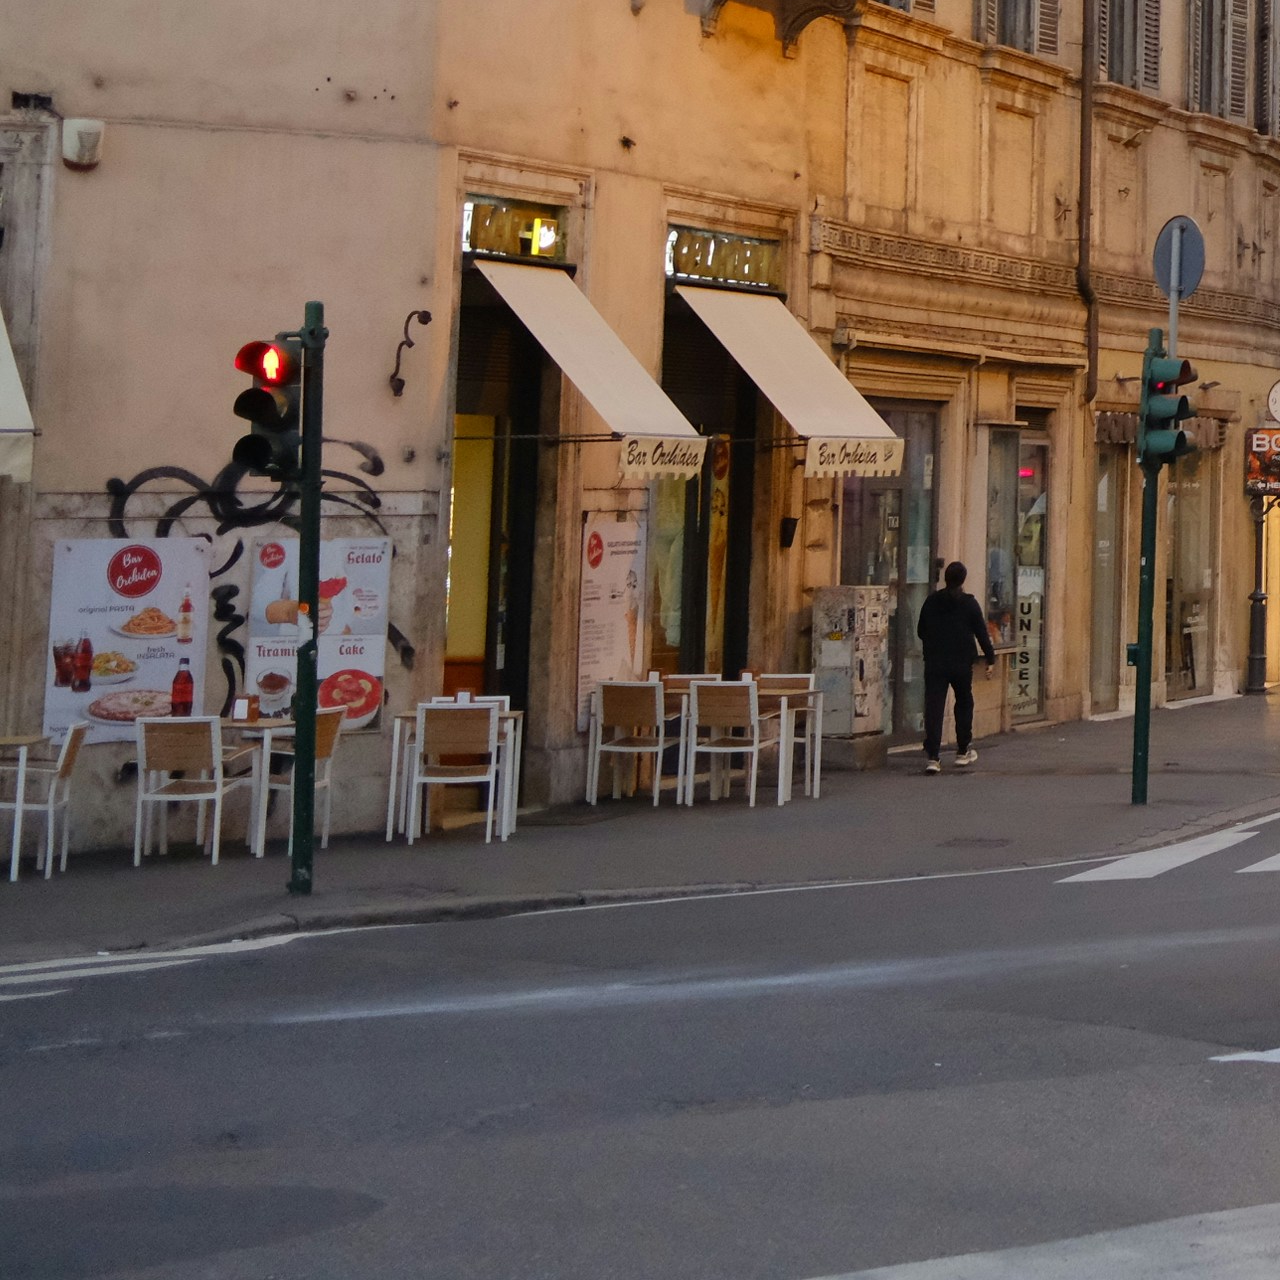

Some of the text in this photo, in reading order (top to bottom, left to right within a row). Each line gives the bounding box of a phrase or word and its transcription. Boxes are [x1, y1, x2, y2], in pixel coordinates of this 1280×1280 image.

[627, 439, 647, 465] Bar
[652, 441, 699, 466] Orchidea
[819, 443, 836, 465] Bar
[123, 554, 143, 567] Bar
[347, 551, 382, 564] Gelato
[117, 568, 158, 589] Orchidea
[78, 605, 108, 614] original
[256, 645, 299, 657] Tirami
[339, 645, 364, 655] Cake
[1018, 603, 1032, 697] UNISEX
